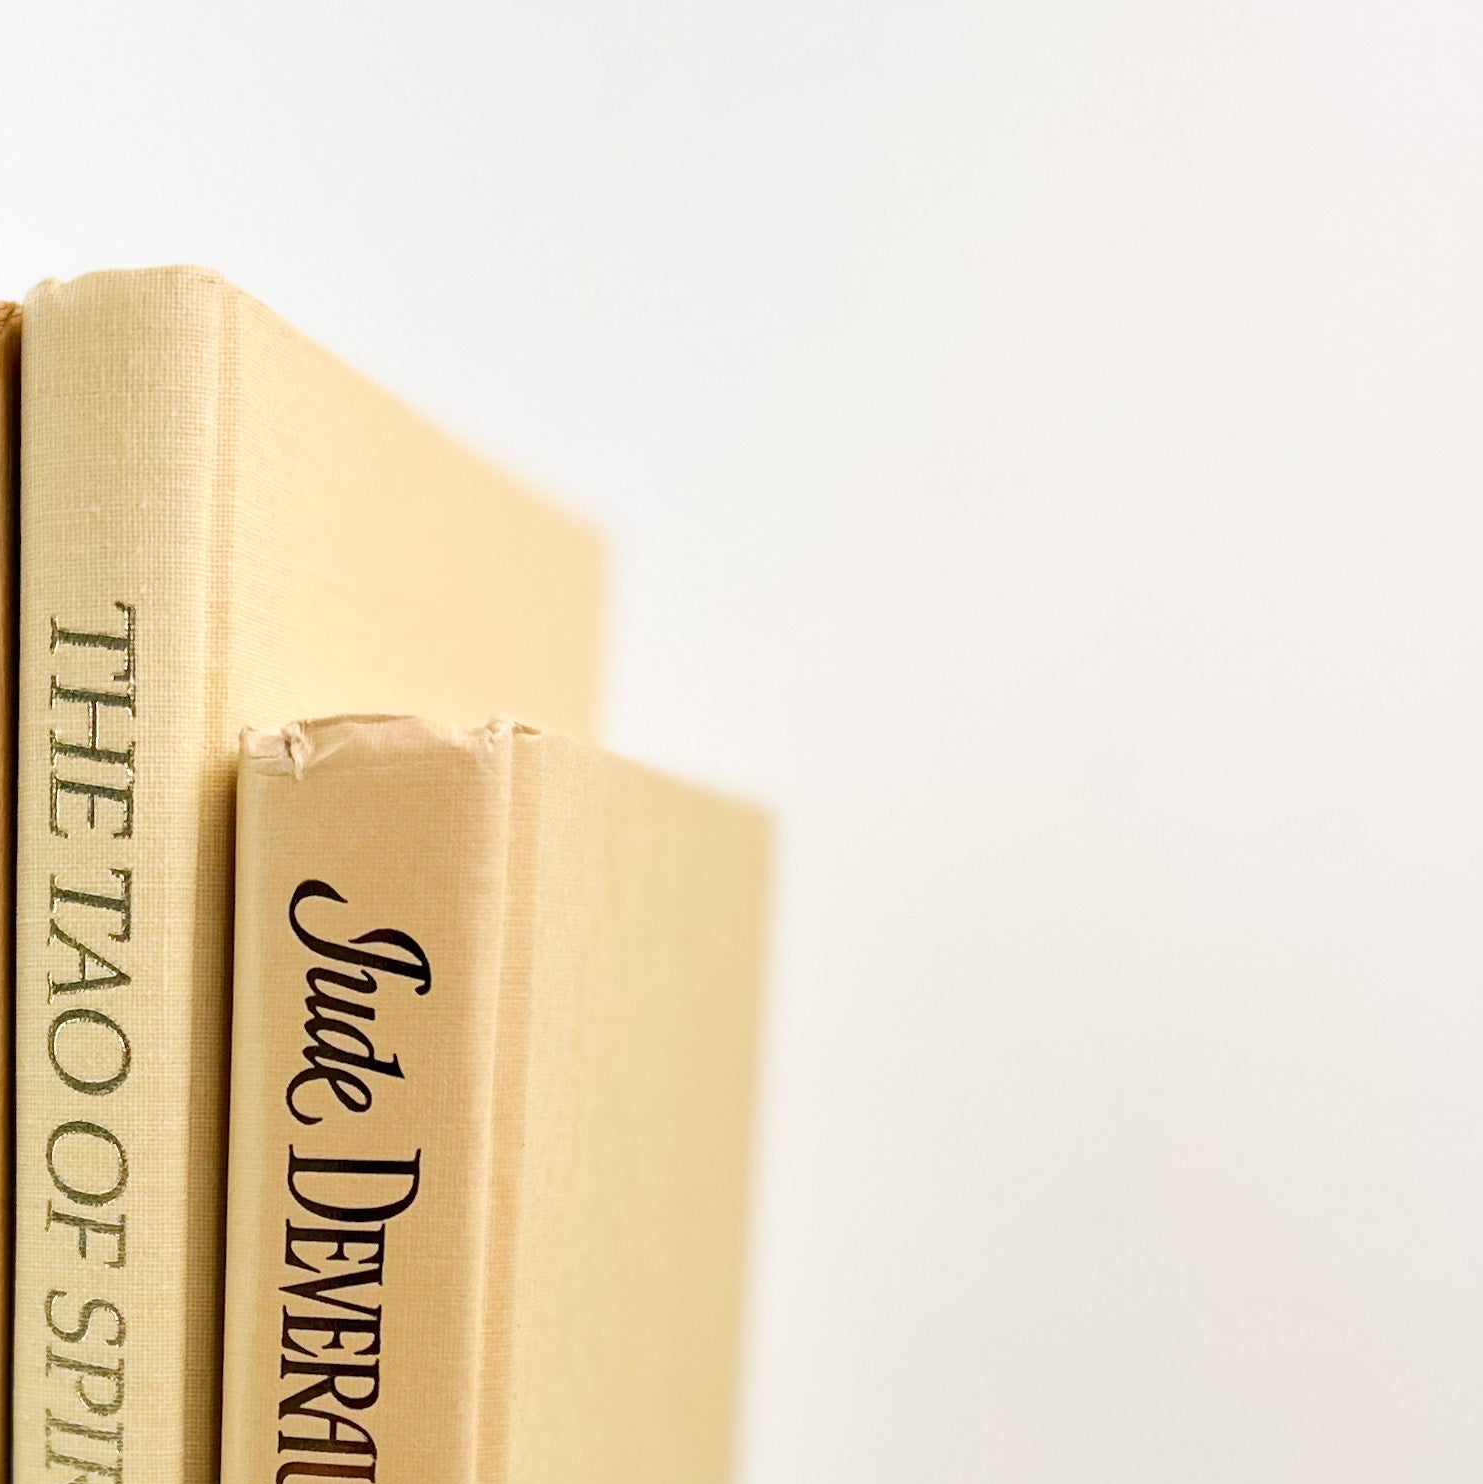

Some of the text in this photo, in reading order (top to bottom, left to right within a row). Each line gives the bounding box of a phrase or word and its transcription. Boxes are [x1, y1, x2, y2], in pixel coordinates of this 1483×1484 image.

[49, 601, 137, 839] THE
[47, 868, 133, 1097] TAO
[285, 879, 432, 1126] Jude
[44, 1120, 130, 1269] OF
